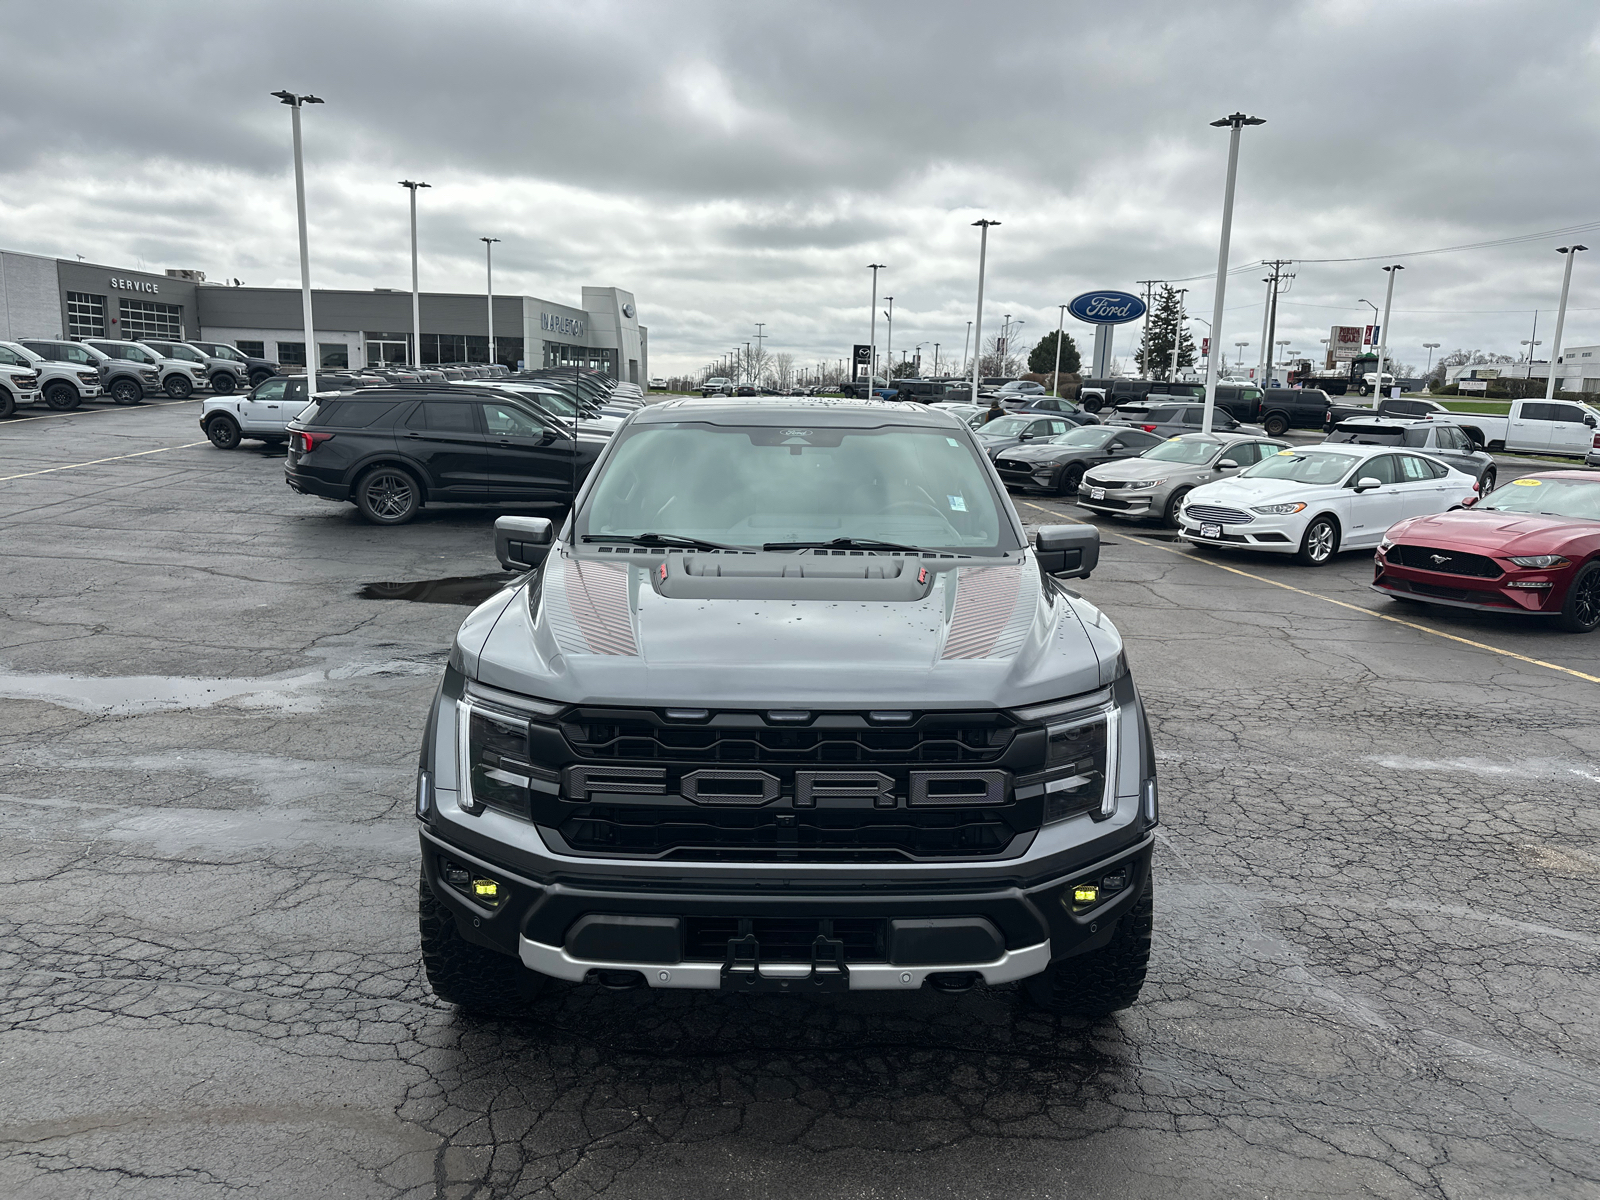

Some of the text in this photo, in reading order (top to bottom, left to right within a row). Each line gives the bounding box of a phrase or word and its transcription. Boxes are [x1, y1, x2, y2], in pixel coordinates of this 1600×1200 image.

[111, 278, 159, 294] SERVICE
[1086, 296, 1132, 317] Ford
[541, 312, 584, 337] NAPLETON
[568, 764, 1010, 807] FORD
